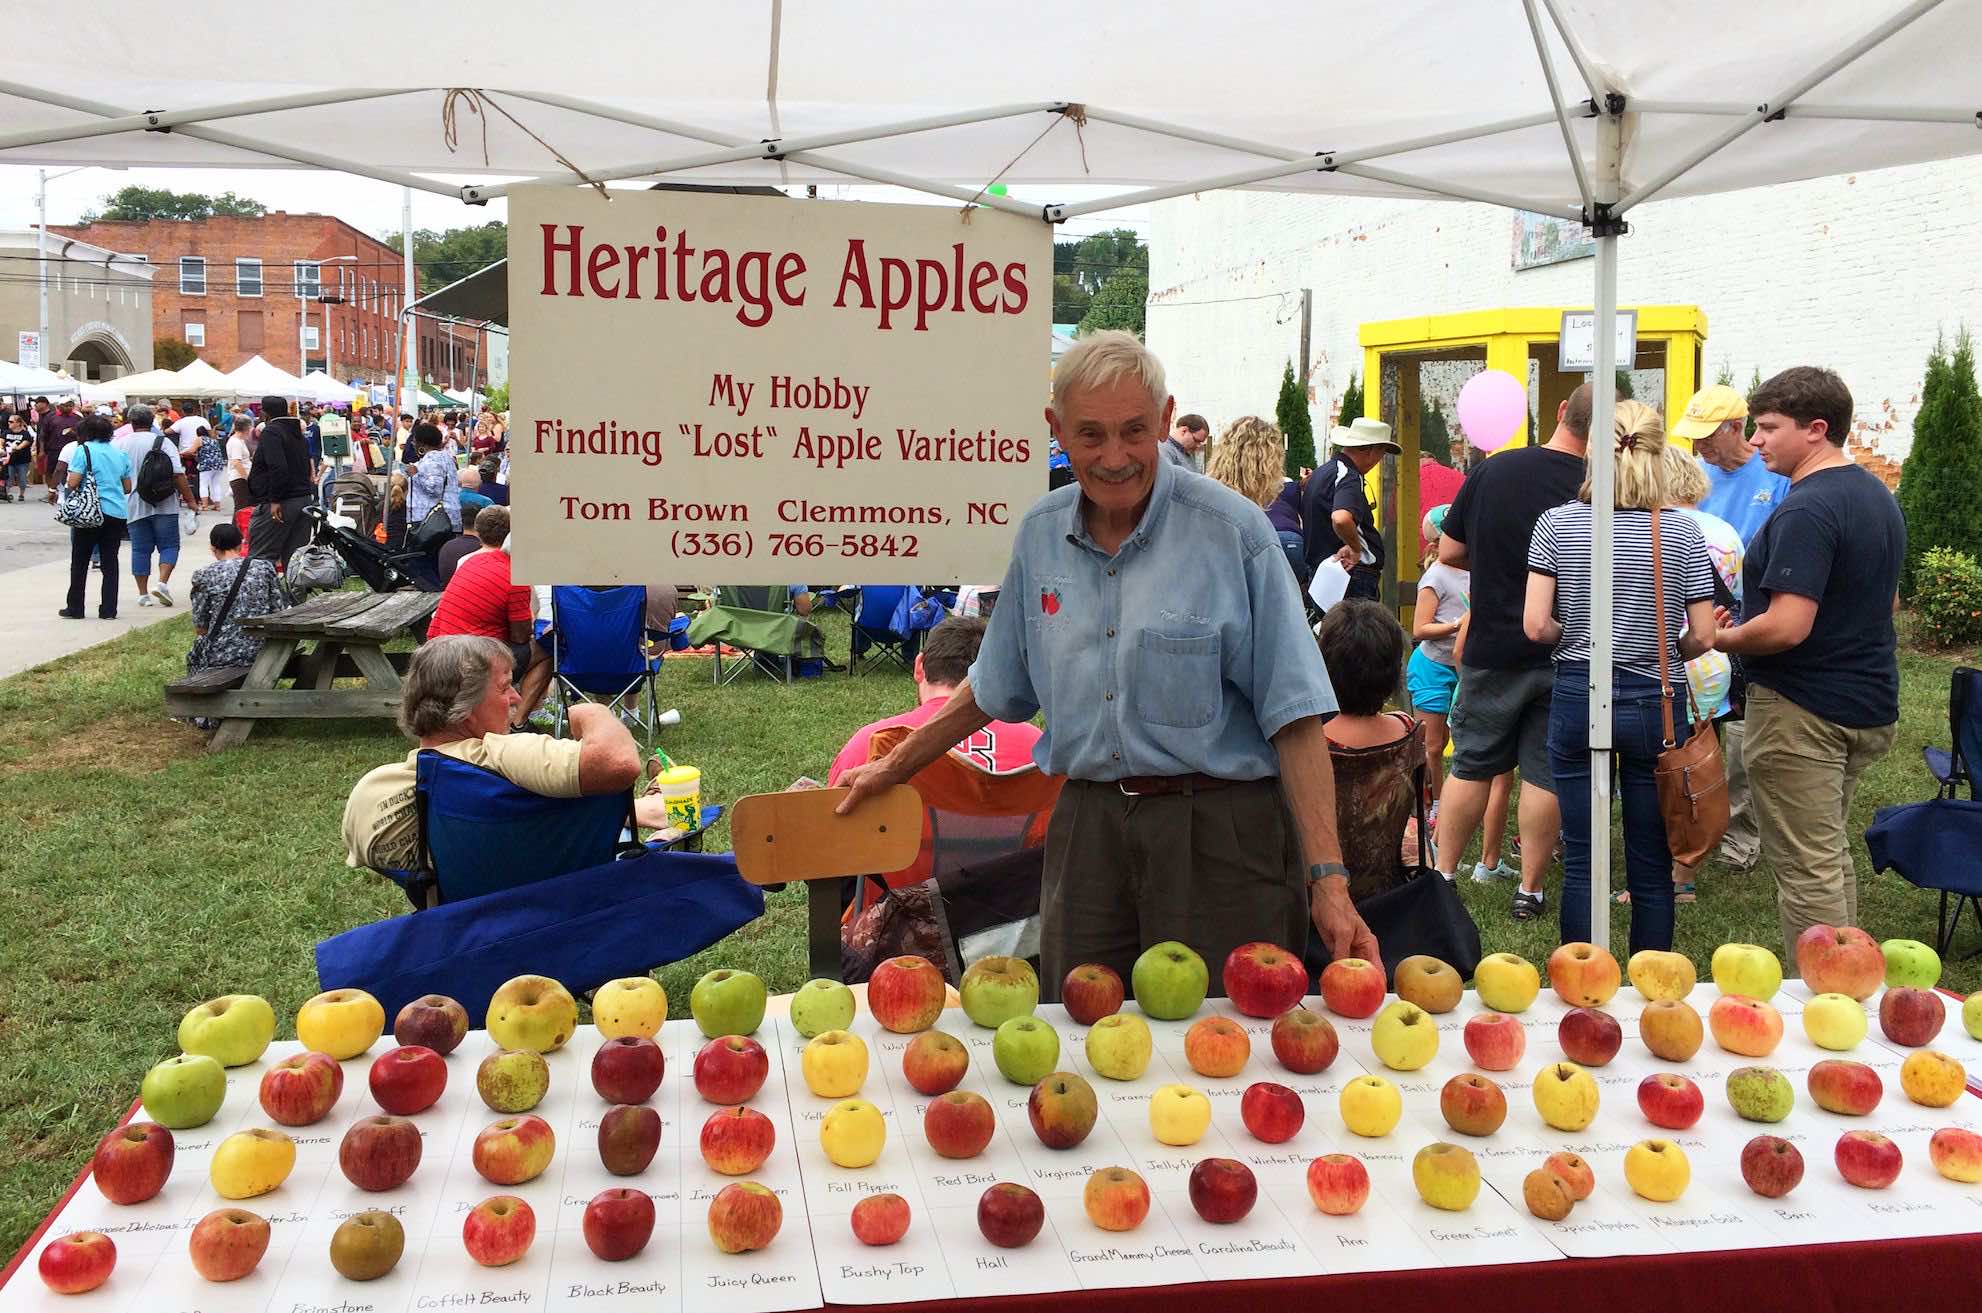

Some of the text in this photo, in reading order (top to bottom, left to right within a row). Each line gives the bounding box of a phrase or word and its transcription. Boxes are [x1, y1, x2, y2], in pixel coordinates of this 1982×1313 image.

[540, 223, 1030, 331] Heritage Apples
[709, 374, 871, 419] My Hobby
[534, 420, 663, 466] Finding
[792, 426, 882, 469] Apple
[897, 427, 1031, 464] Varieties
[559, 497, 1009, 527] Tom Brown Clemmons, NC
[671, 531, 919, 559] (336) 766-5842
[935, 1172, 999, 1187] Red Bird
[1034, 1167, 1083, 1182] Virginia
[828, 1181, 852, 1194] Fall
[126, 1221, 180, 1234] Delicious
[1429, 1228, 1477, 1242] Green
[1335, 1234, 1369, 1249] Ann
[975, 1256, 1009, 1270] Hall
[1070, 1248, 1110, 1264] Grand
[840, 1262, 927, 1280] Bushy Top
[707, 1271, 798, 1289] Juicy Queen
[479, 1289, 532, 1306] Beauty
[568, 1280, 667, 1299] Black Beauty
